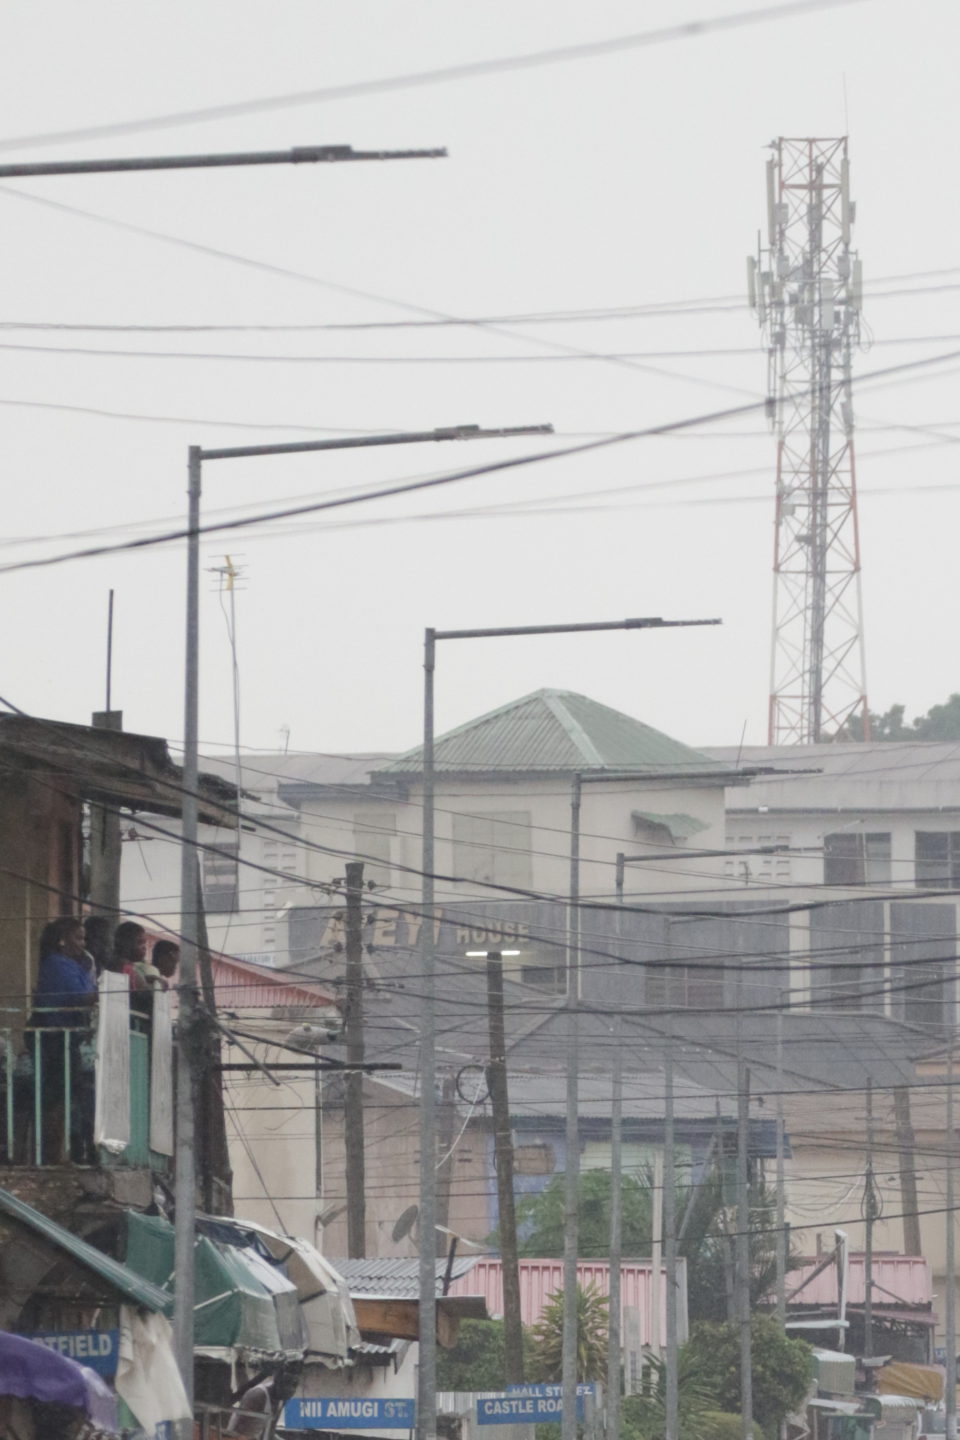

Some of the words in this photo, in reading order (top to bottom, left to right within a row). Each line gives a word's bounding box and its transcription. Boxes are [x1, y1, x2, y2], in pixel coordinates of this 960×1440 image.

[319, 907, 443, 946] AEYI
[456, 921, 530, 943] HOUSE
[300, 1401, 322, 1418] NII
[326, 1401, 379, 1418] AMUGI
[484, 1400, 534, 1415] CASTLE
